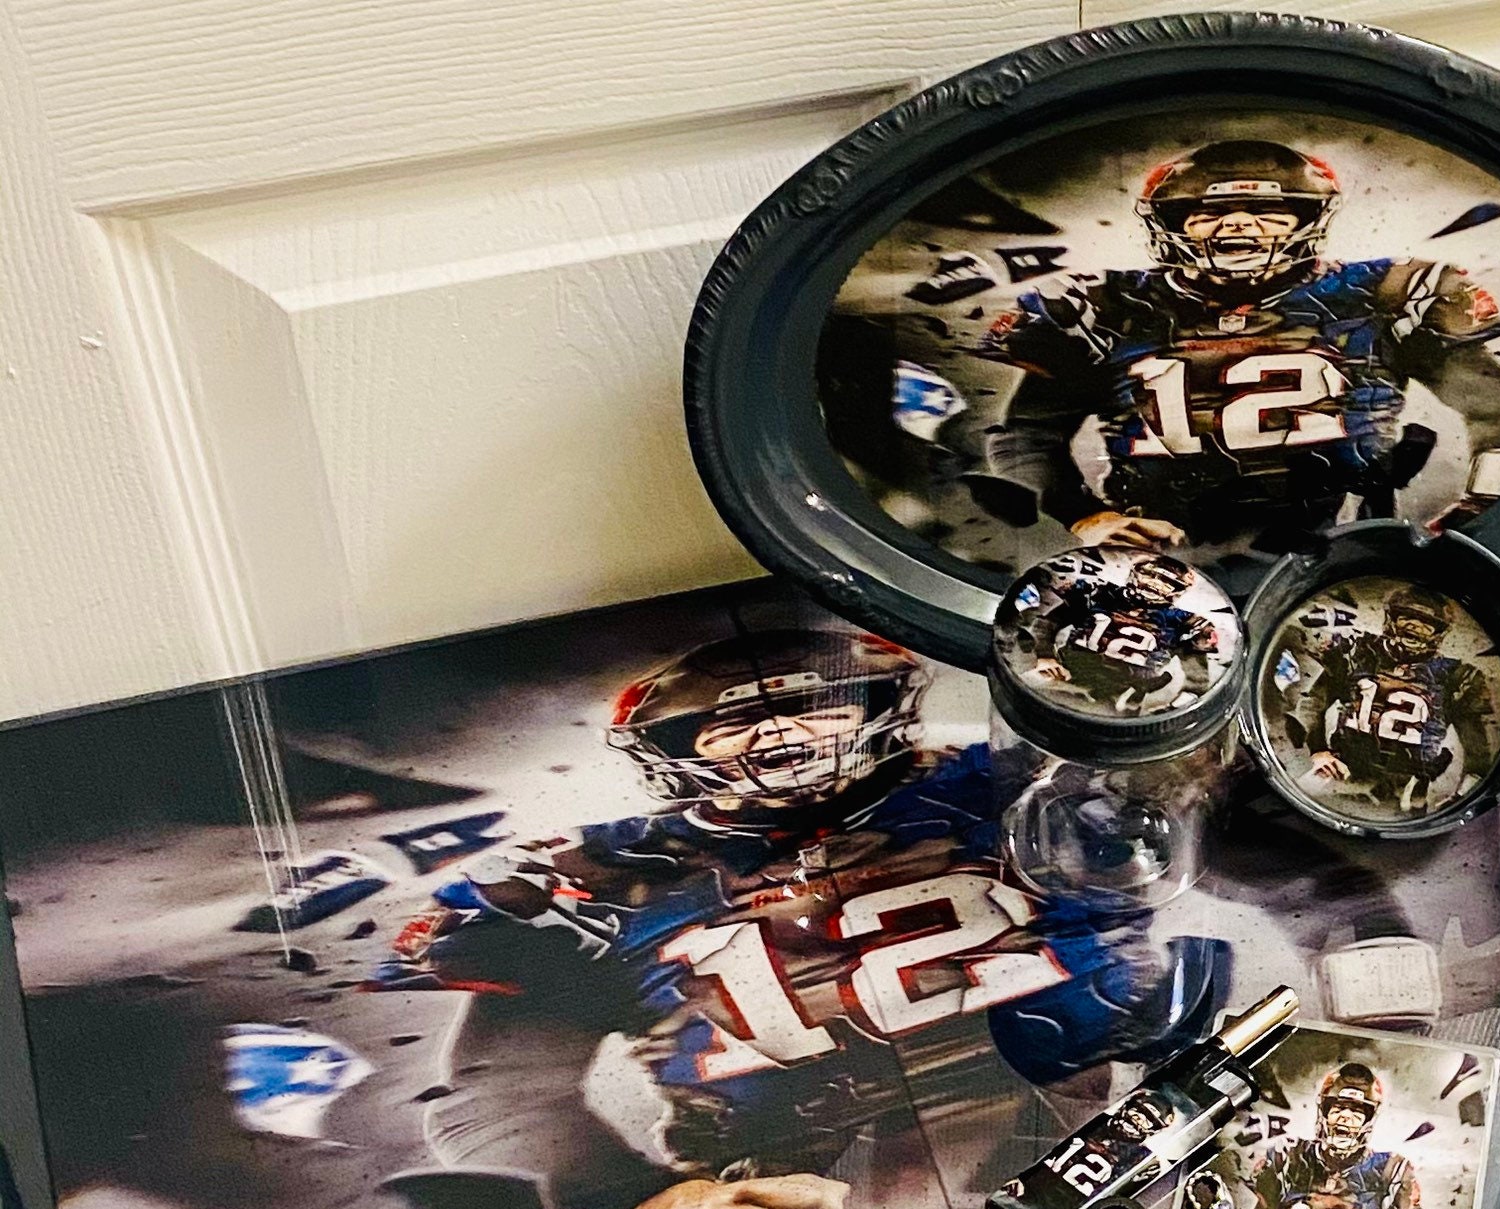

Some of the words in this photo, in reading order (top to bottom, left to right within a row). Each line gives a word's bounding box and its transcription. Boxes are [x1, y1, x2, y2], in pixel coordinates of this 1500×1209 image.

[1126, 350, 1348, 460] 12
[1072, 612, 1158, 667] 12
[1343, 677, 1430, 746] 12
[658, 872, 1071, 1083] 12
[1043, 1136, 1114, 1197] 12
